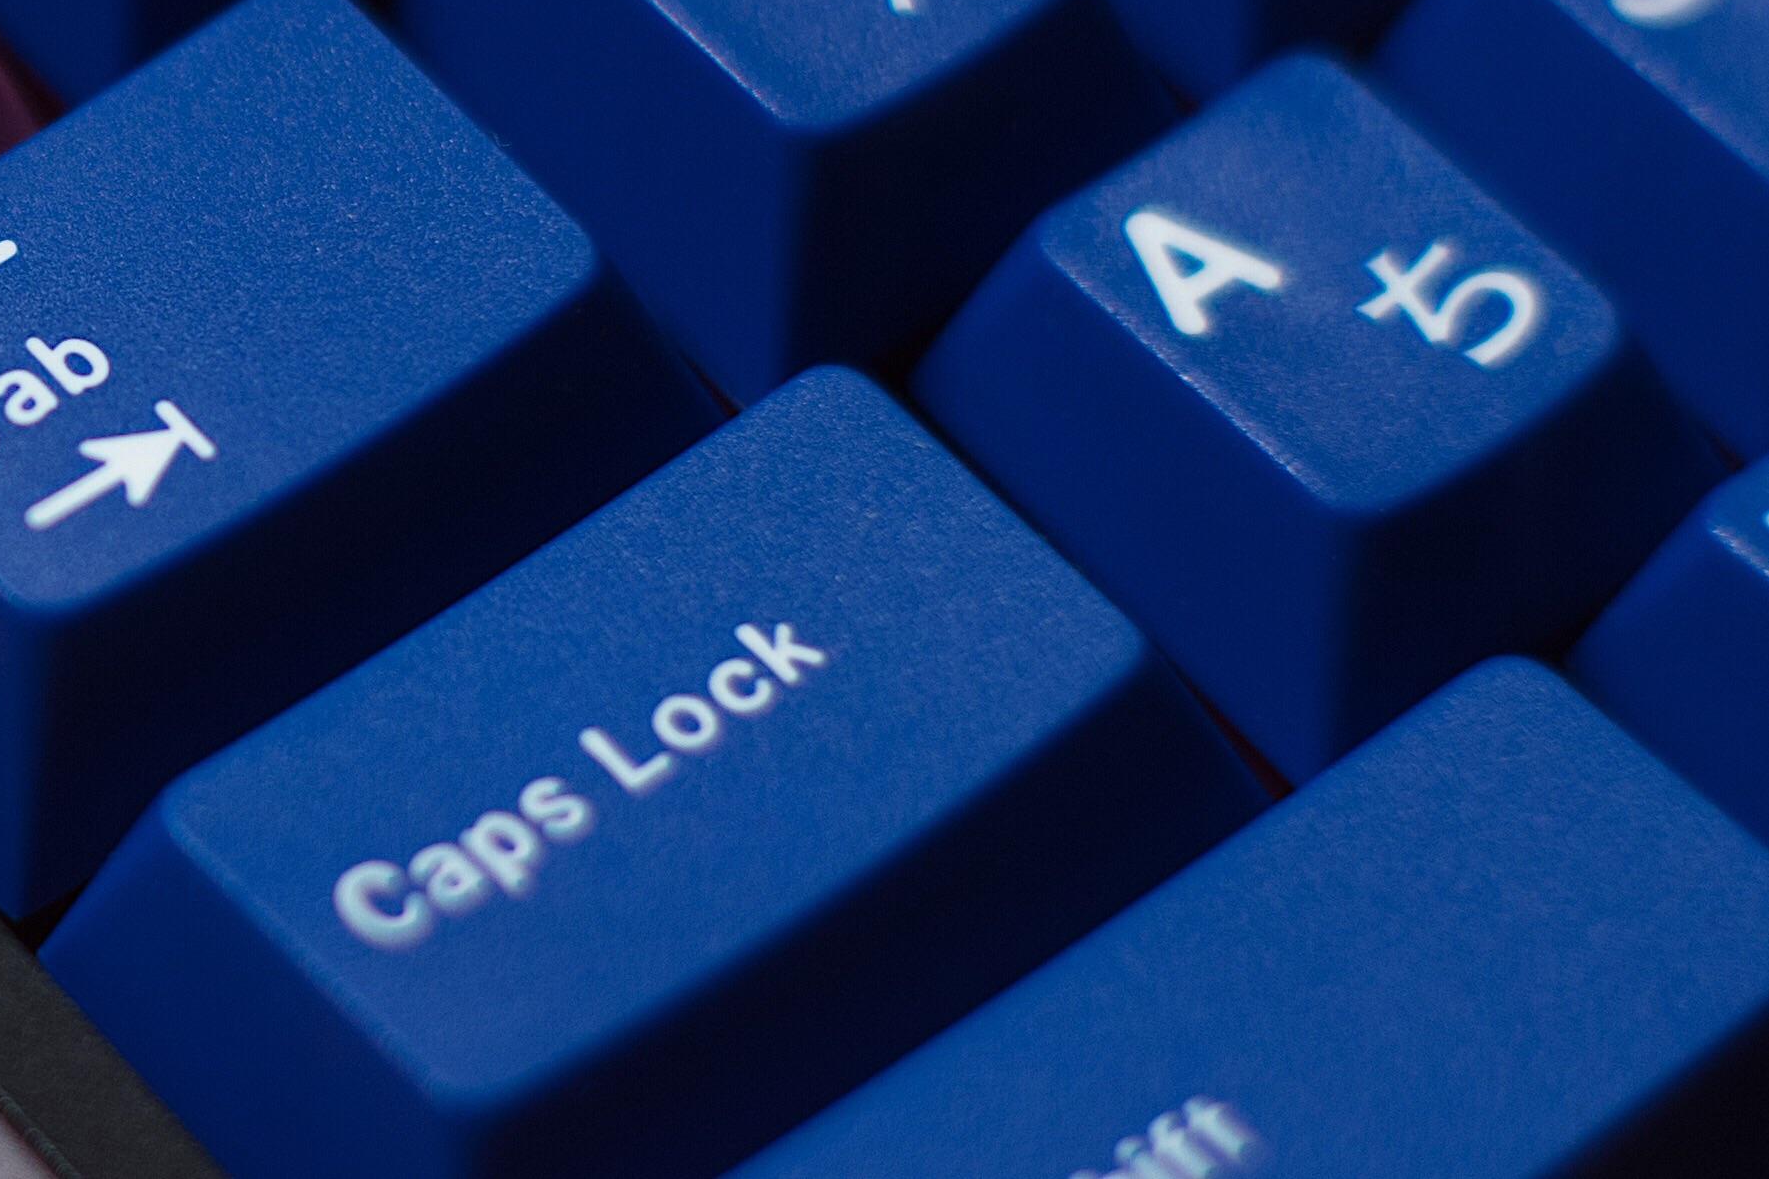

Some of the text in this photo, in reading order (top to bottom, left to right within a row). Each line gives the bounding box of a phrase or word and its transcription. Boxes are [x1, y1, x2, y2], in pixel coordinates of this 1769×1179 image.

[1122, 207, 1542, 367] A ち
[334, 622, 827, 949] Caps Lock
